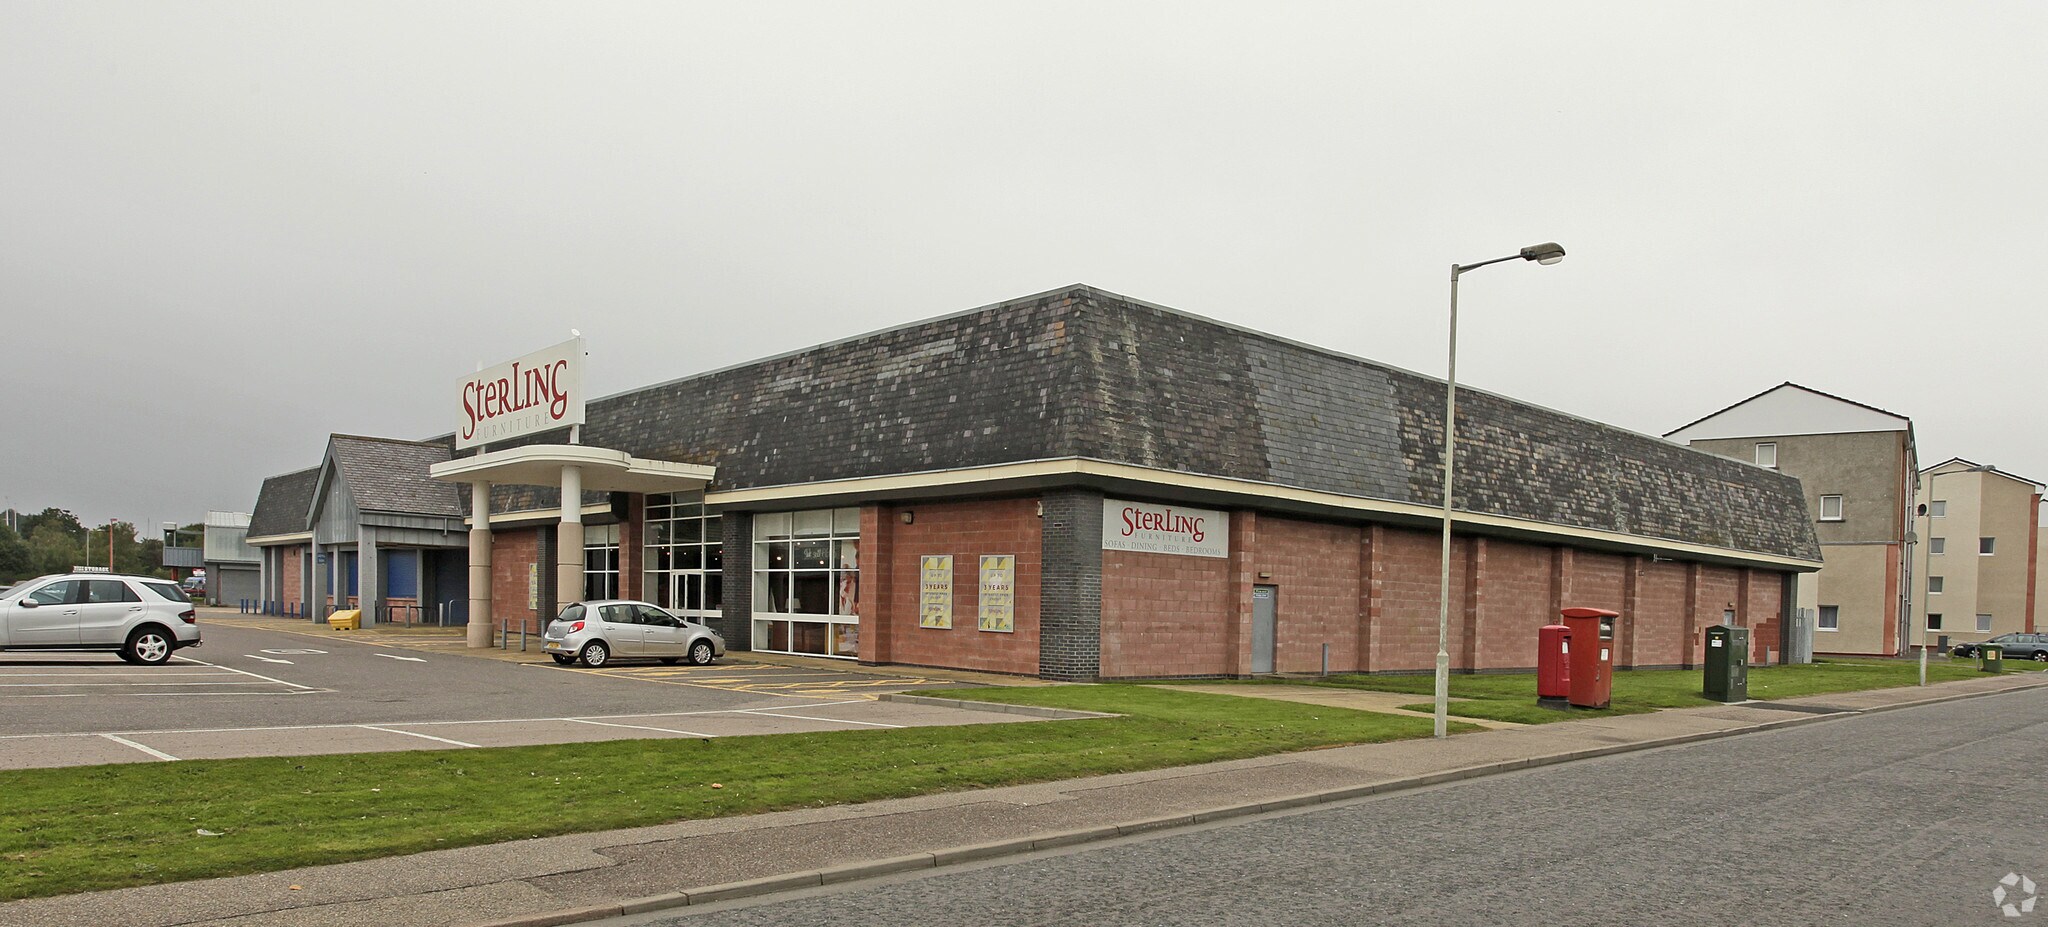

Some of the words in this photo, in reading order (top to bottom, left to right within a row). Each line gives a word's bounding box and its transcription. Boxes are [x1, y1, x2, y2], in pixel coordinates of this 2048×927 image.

[476, 412, 548, 440] FURNITURE
[1134, 533, 1192, 543] FURNITURE
[1104, 539, 1126, 549] SOFAS
[1131, 541, 1157, 550] DINING
[1163, 545, 1180, 553] BEDS
[1185, 546, 1221, 556] BEDROOMS
